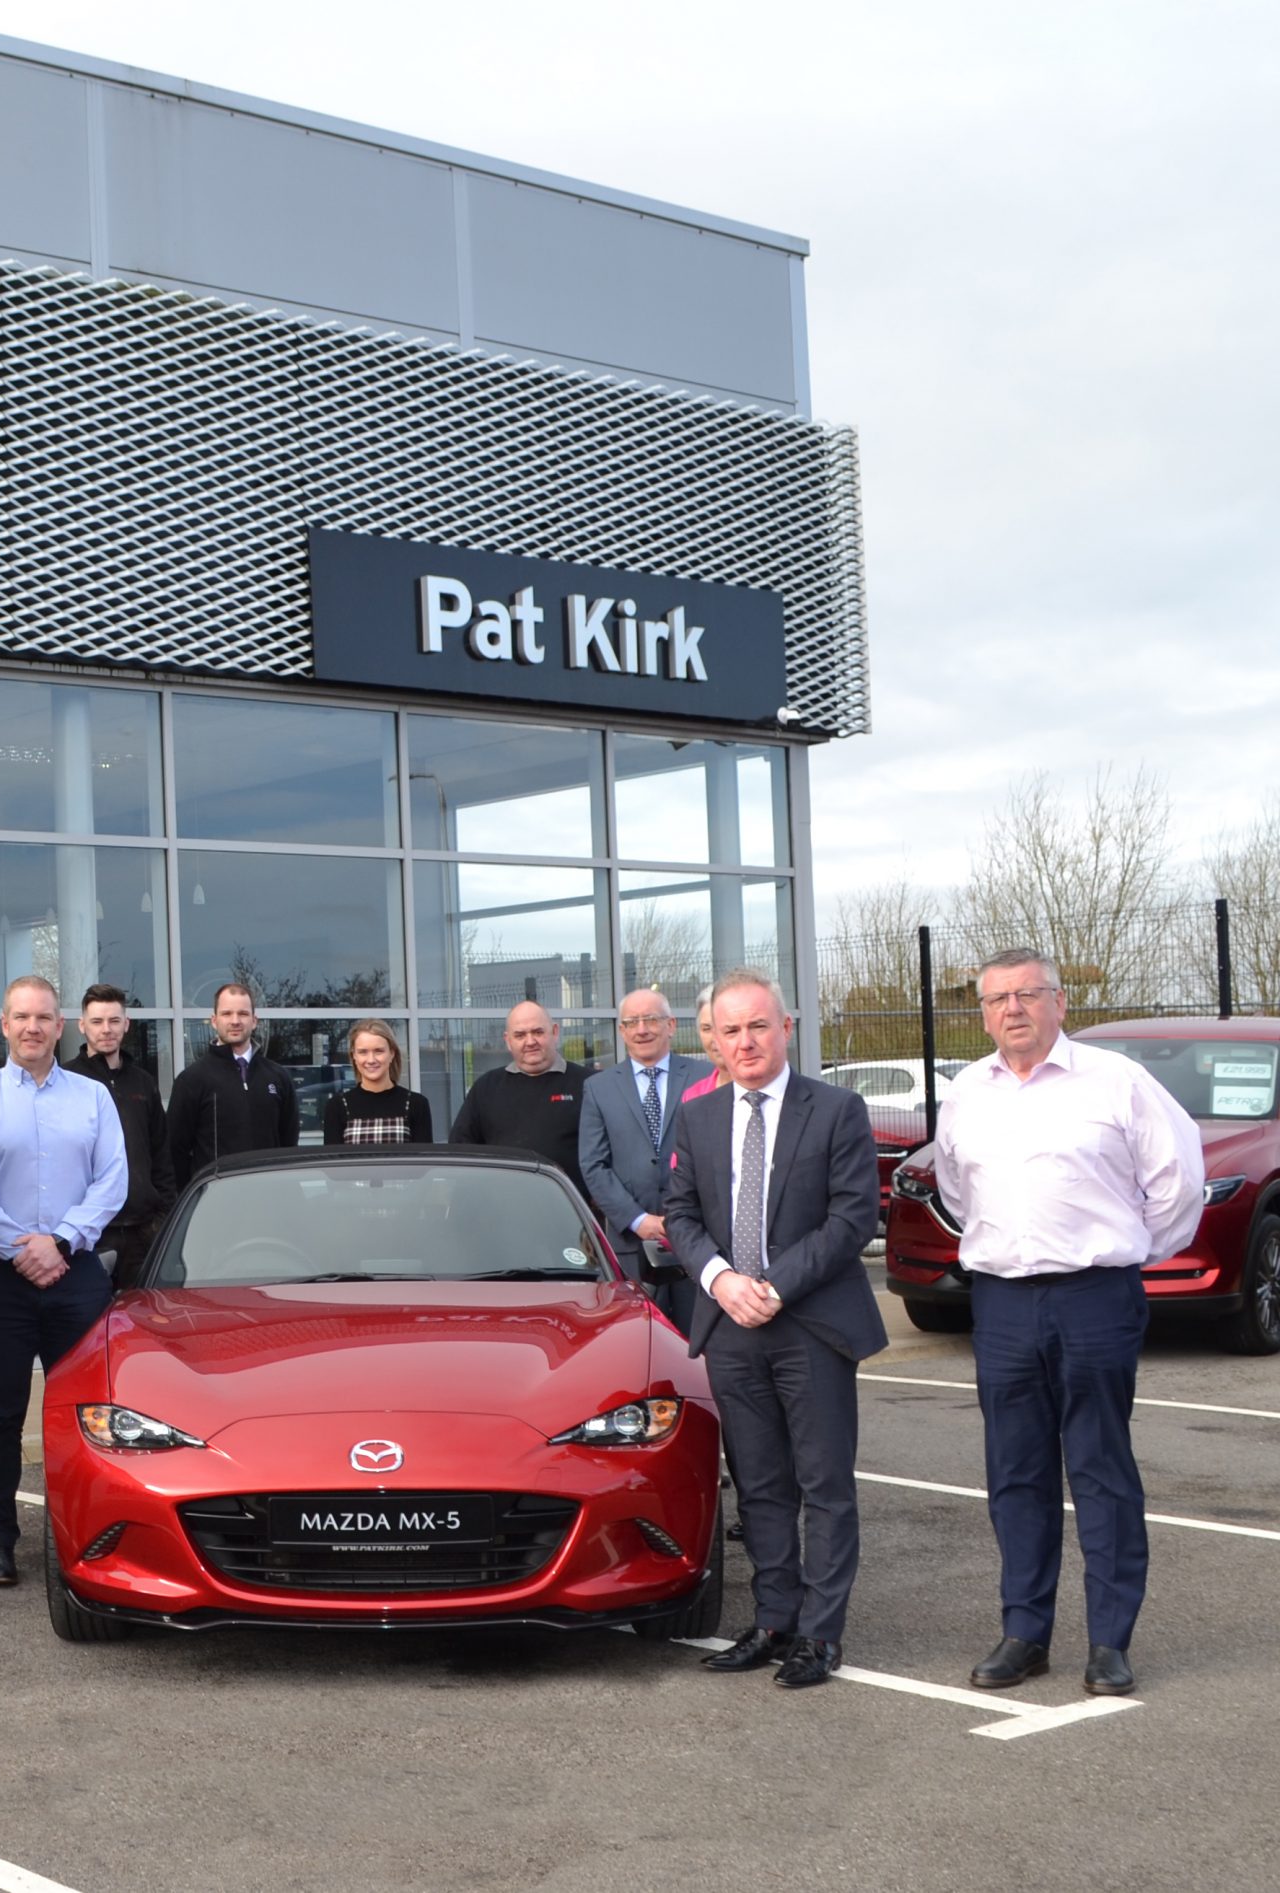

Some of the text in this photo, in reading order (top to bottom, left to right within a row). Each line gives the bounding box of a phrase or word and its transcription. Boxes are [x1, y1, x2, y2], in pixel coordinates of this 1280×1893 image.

[420, 575, 708, 681] Pat Kirk
[300, 1511, 461, 1531] MAZDA MX-5
